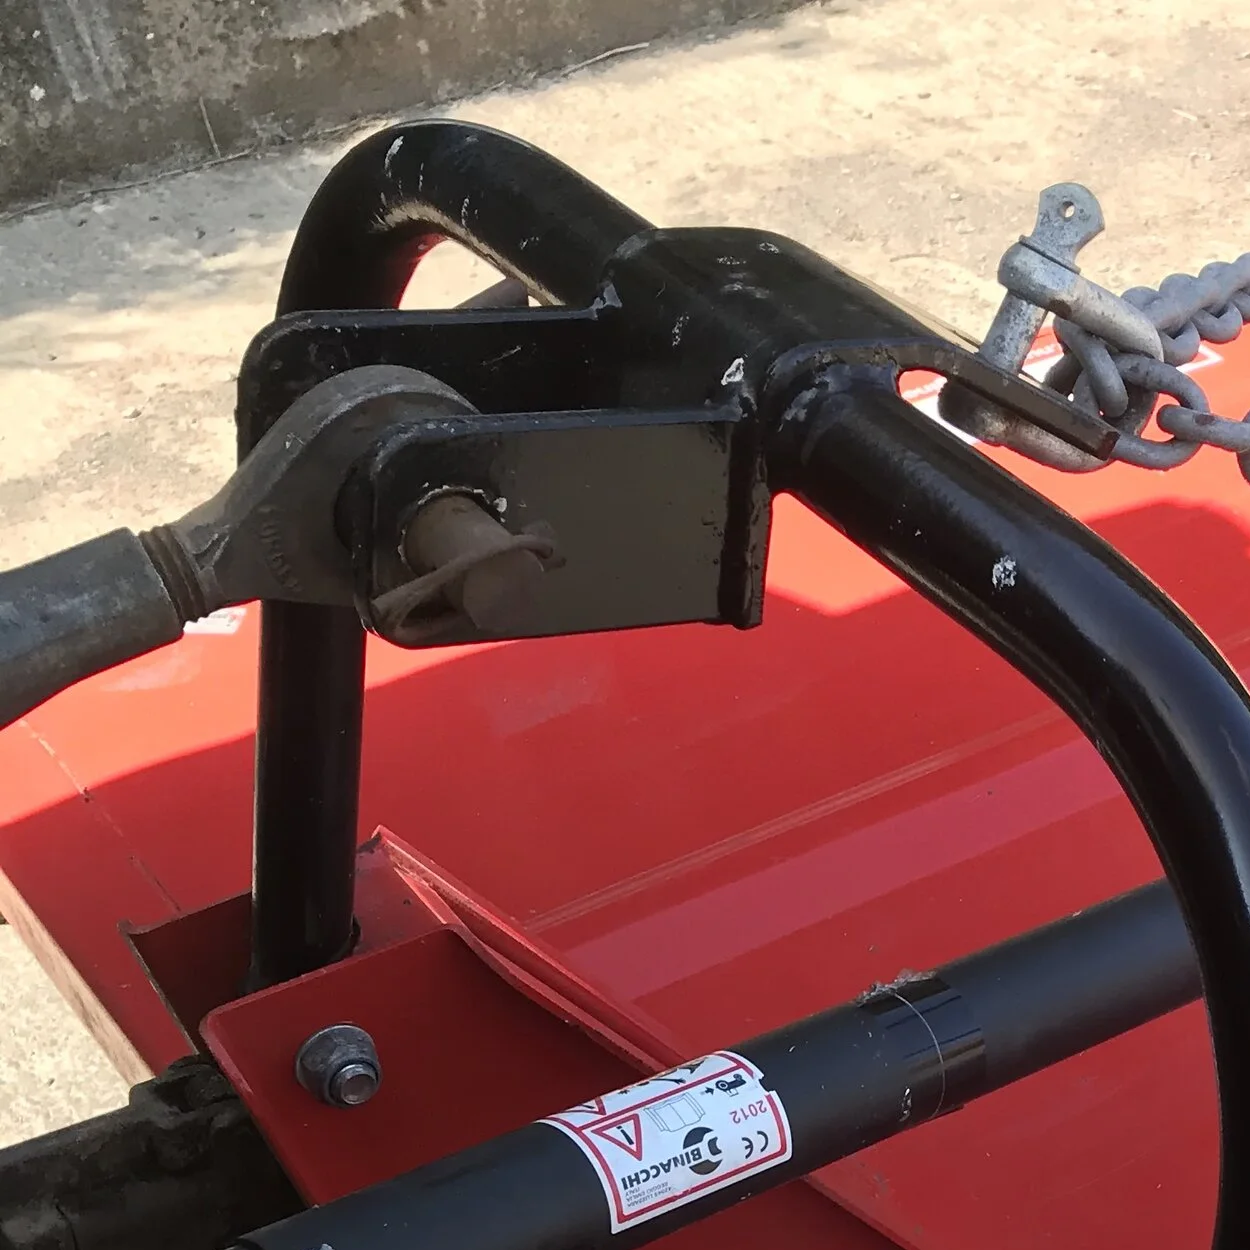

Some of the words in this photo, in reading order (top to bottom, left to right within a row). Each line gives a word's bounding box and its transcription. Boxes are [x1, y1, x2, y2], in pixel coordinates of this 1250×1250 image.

[729, 1099, 767, 1124] 2012
[741, 1130, 769, 1159] CE
[621, 1147, 702, 1190] BINACCHI
[625, 1187, 640, 1197] ITALY
